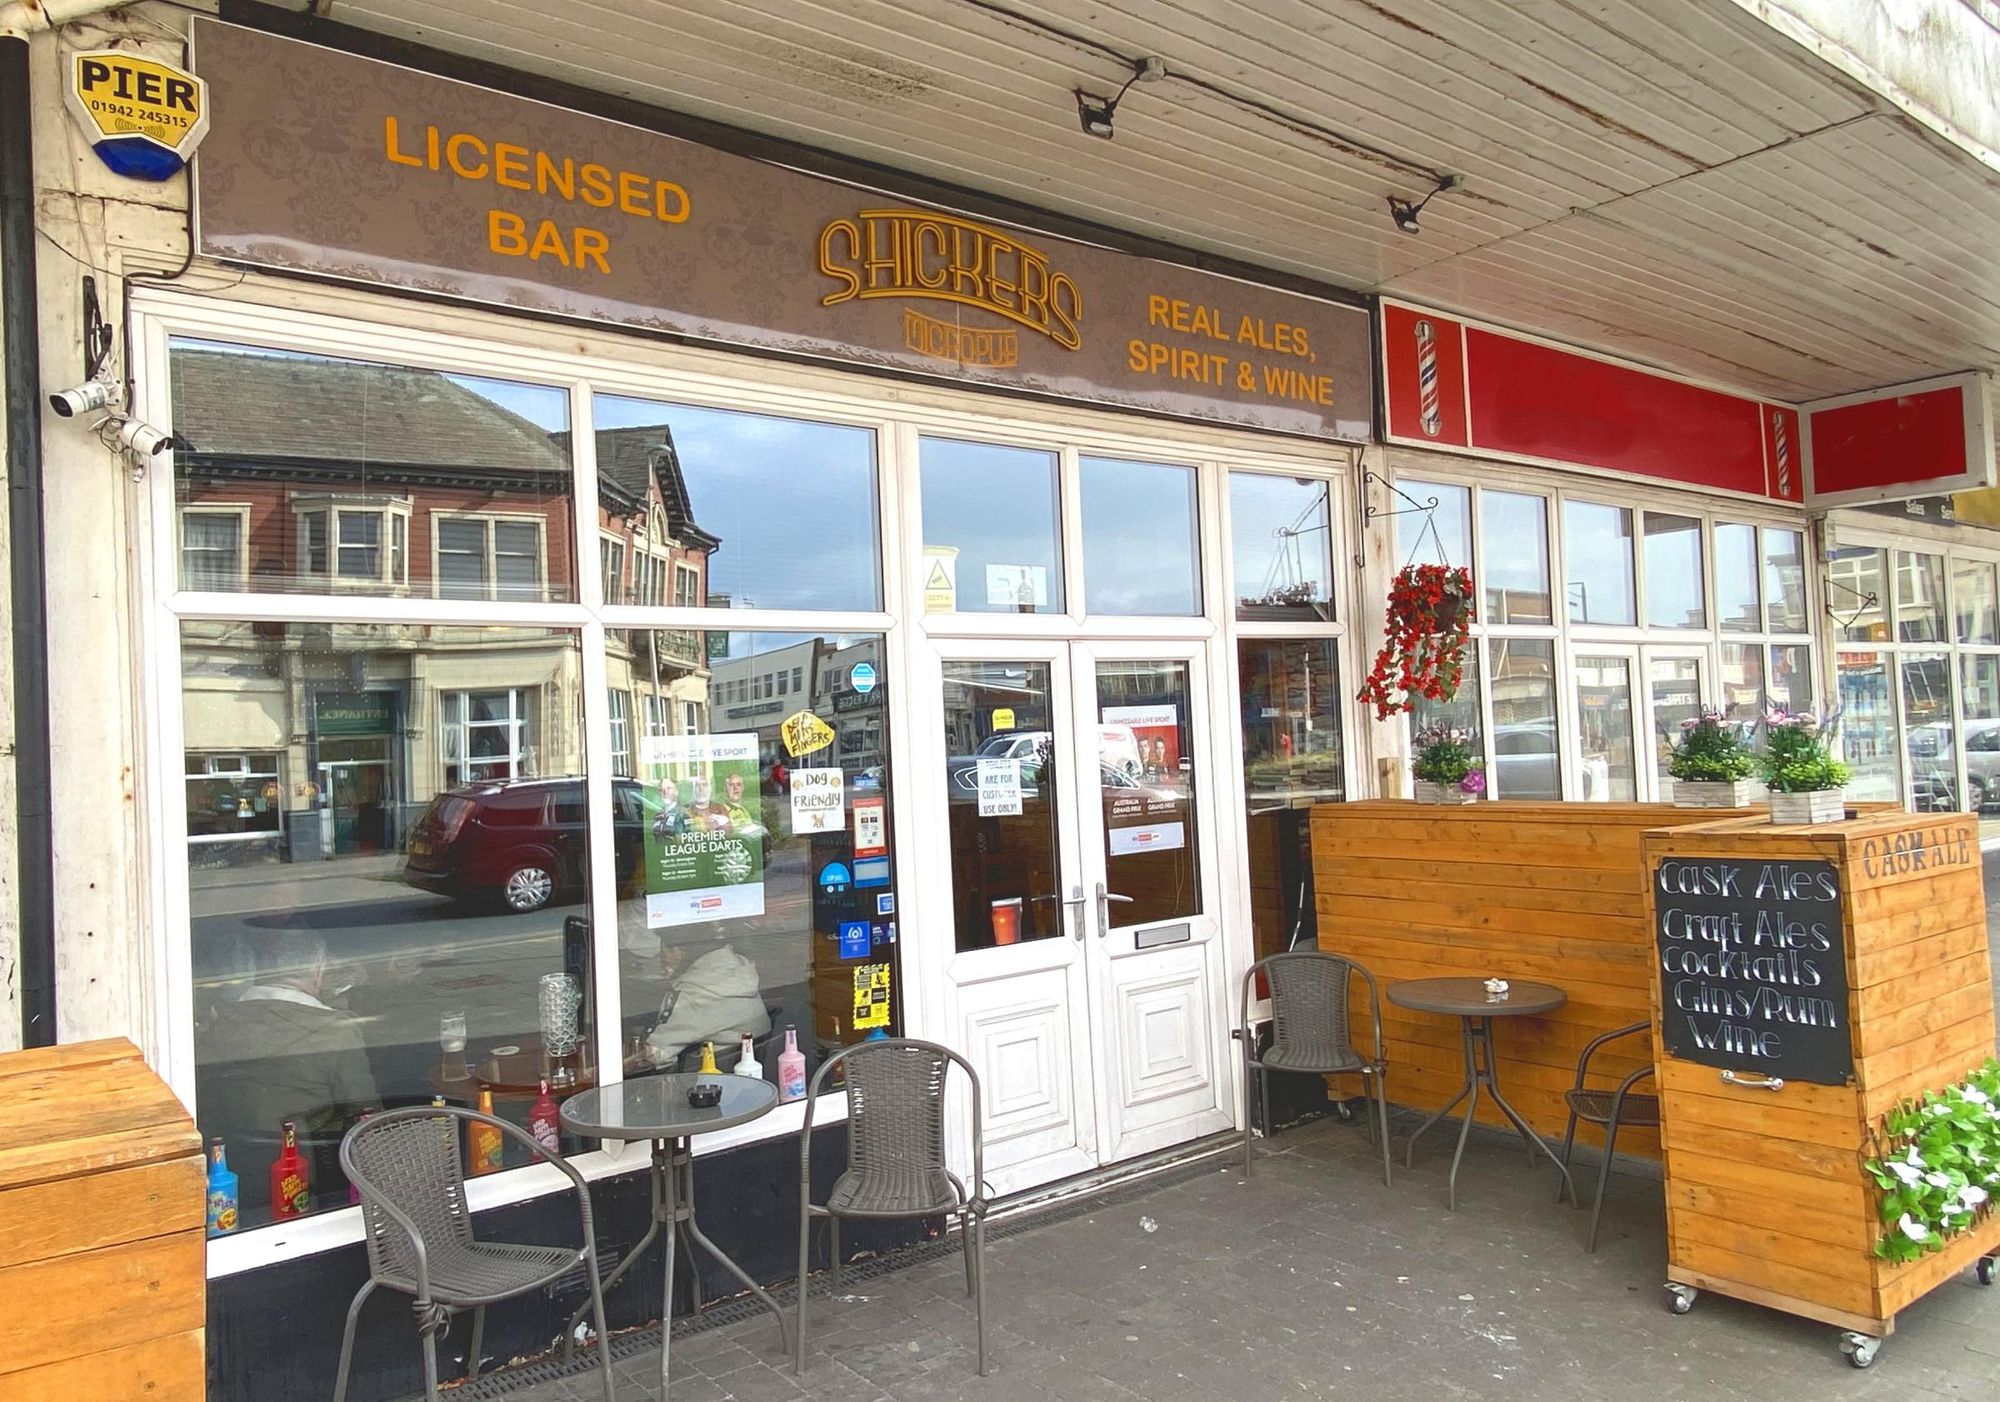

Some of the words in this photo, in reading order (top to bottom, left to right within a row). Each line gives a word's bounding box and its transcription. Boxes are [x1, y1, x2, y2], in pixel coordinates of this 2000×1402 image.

[82, 59, 197, 113] PIER
[91, 100, 133, 117] 01942
[138, 109, 188, 128] 245315
[386, 116, 691, 224] LICENSED
[488, 209, 611, 274] BAR
[820, 208, 1082, 351] SHICKERS
[903, 307, 1019, 369] MICROPUB
[1149, 294, 1230, 340] REAL
[1237, 315, 1317, 363] ALES,
[1128, 339, 1229, 387] SPIRIT
[1236, 361, 1257, 392] &
[1263, 365, 1335, 406] WINE
[982, 788, 1017, 800] CUSTOER
[983, 803, 996, 815] USE
[664, 841, 706, 857] LEAGUE
[709, 838, 744, 853] DARTS
[681, 830, 726, 844] PREMIER
[1863, 831, 1927, 880] CASK
[1931, 827, 1970, 868] ALE
[1754, 864, 1837, 901] Ales
[1662, 908, 1743, 952] Craft
[1754, 910, 1831, 951] Ales
[1662, 946, 1821, 986] Cocktails
[1674, 979, 1838, 1029] Gins/Rum
[1687, 1015, 1782, 1058] Wine
